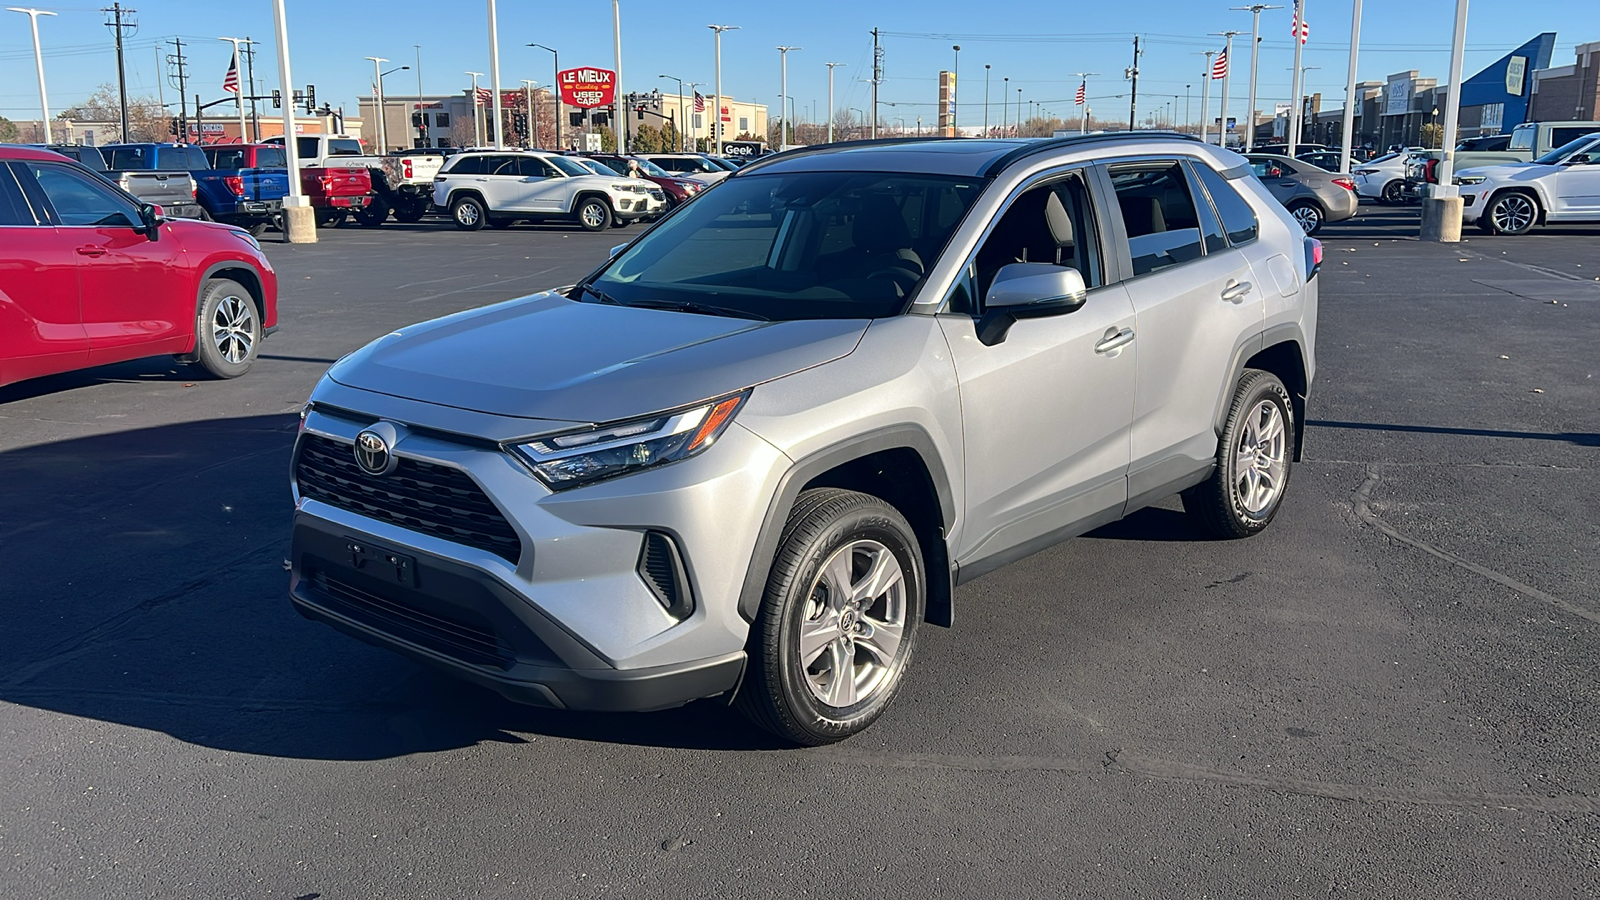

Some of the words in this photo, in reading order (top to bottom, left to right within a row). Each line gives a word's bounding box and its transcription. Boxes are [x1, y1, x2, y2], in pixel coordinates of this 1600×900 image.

[563, 72, 575, 83] LE
[577, 69, 610, 83] MIEUX
[1509, 62, 1523, 76] BEST
[1508, 75, 1521, 89] BUY
[576, 98, 601, 106] CARS
[725, 144, 753, 156] Geek
[1270, 384, 1292, 412] TOYO
